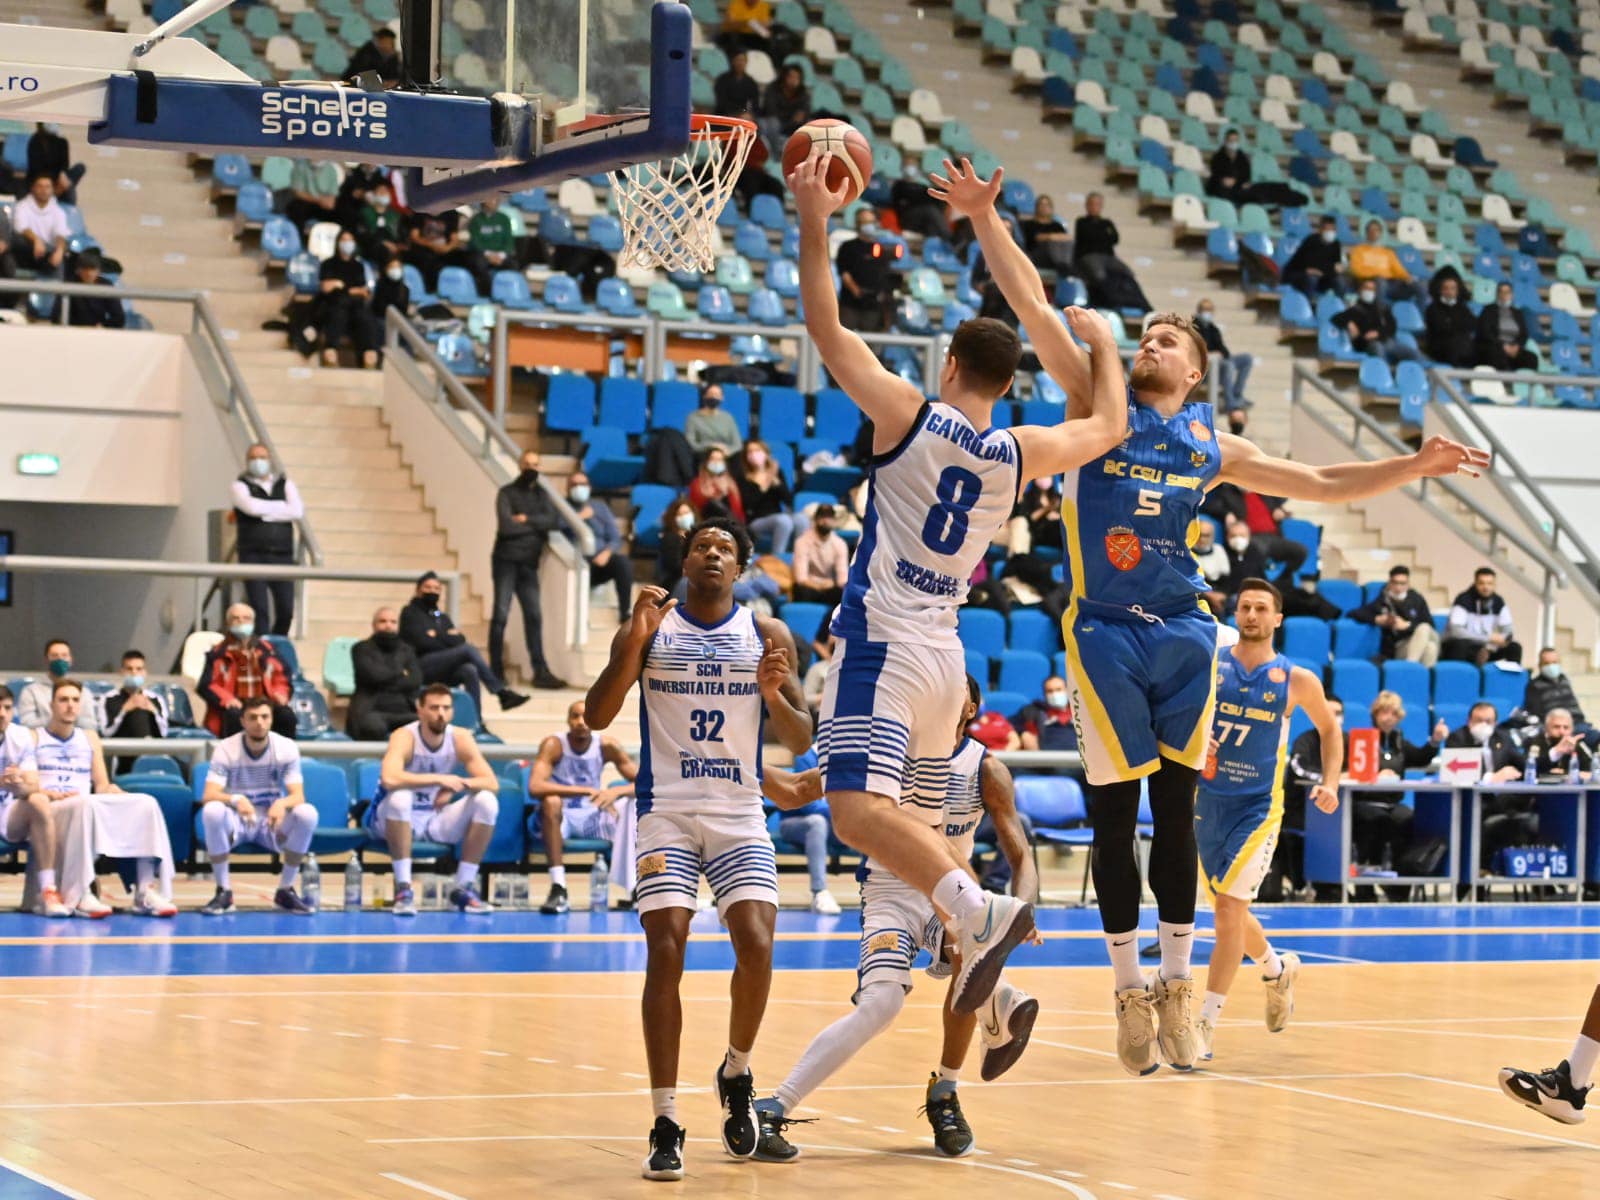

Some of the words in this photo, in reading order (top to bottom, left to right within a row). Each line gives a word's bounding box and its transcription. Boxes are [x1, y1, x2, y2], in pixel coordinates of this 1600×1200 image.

[261, 91, 388, 118] Schede
[1103, 458, 1128, 477] BC
[1129, 464, 1163, 484] CSU
[921, 465, 983, 556] 8
[1133, 488, 1164, 516] 5
[696, 663, 722, 677] SCM
[690, 709, 725, 743] 32
[1217, 720, 1252, 747] 77
[1352, 738, 1367, 773] 5
[1513, 855, 1527, 876] 9
[1550, 855, 1568, 875] 15
